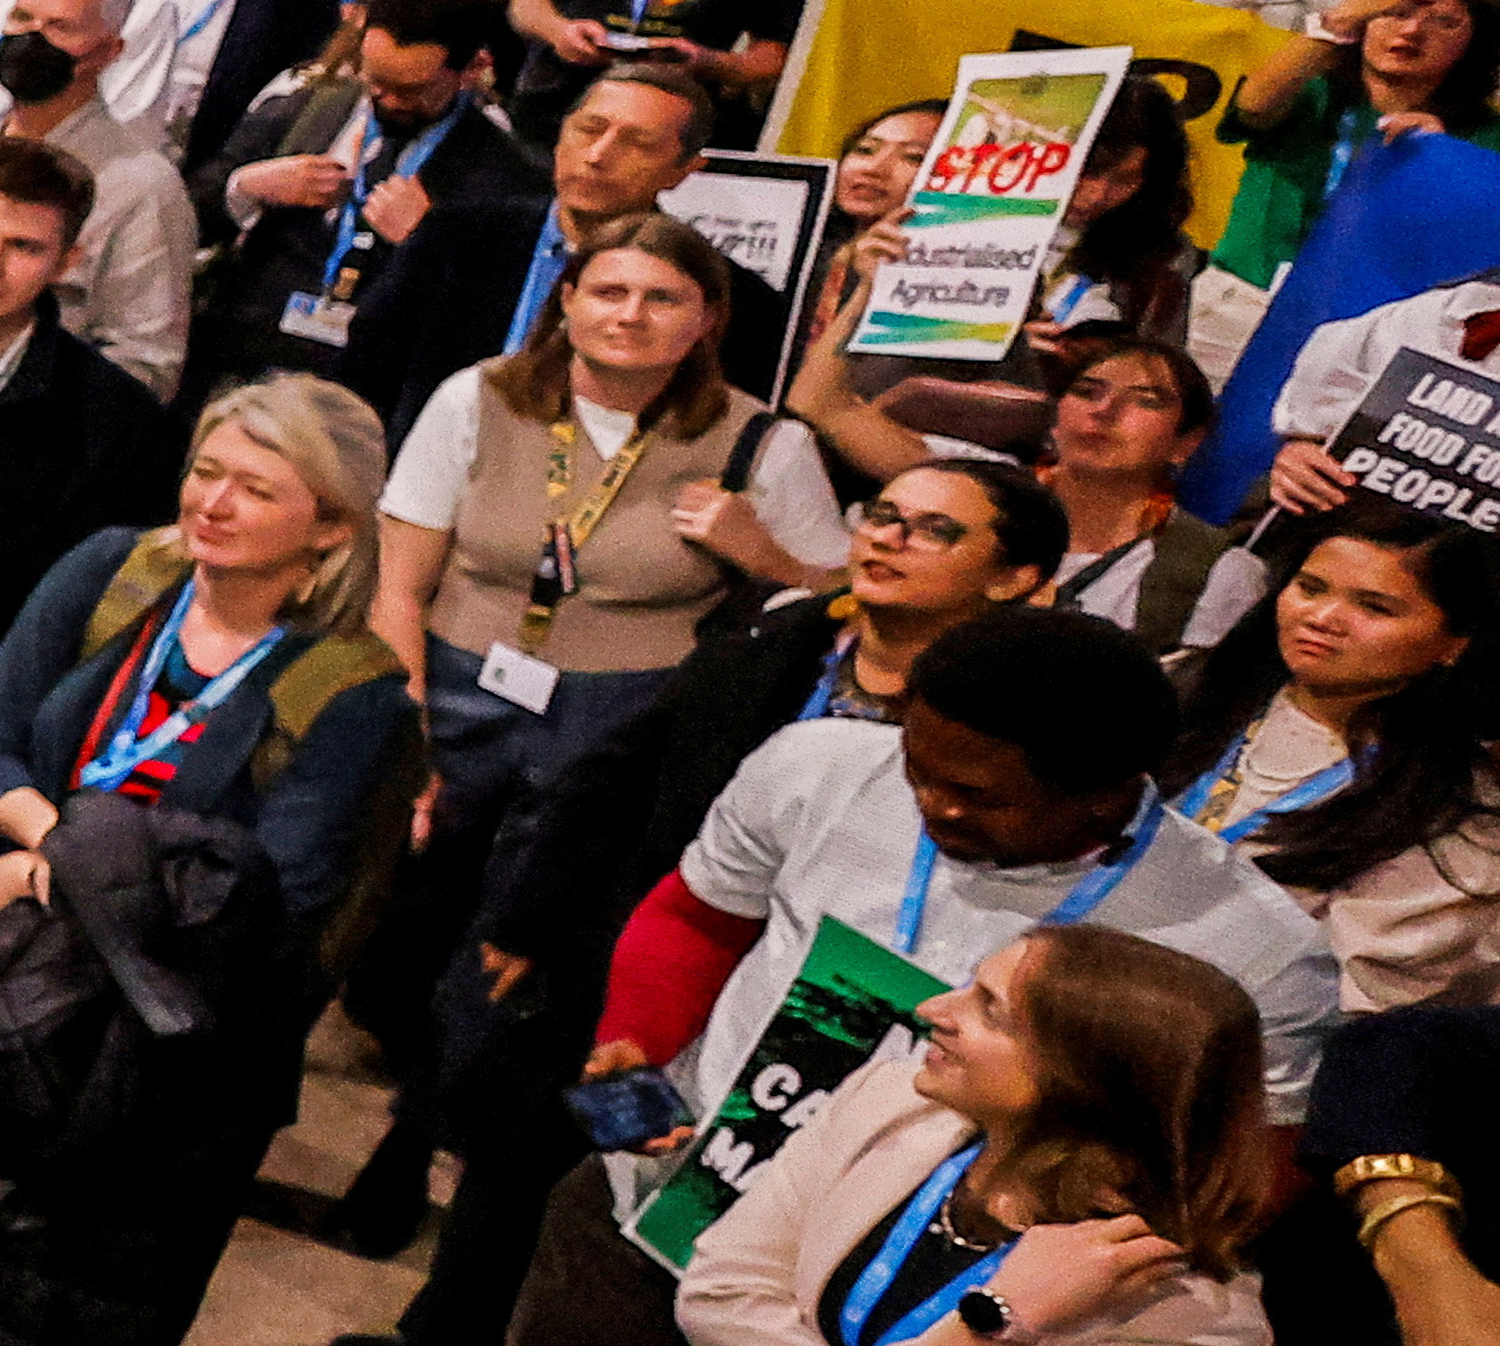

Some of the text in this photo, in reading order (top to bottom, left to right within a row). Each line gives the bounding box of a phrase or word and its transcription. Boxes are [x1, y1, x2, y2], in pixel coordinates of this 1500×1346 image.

[924, 141, 1073, 194] STOP
[1406, 372, 1494, 426] LAND
[1376, 411, 1467, 466] FOOD
[1341, 446, 1500, 533] PEOPLE
